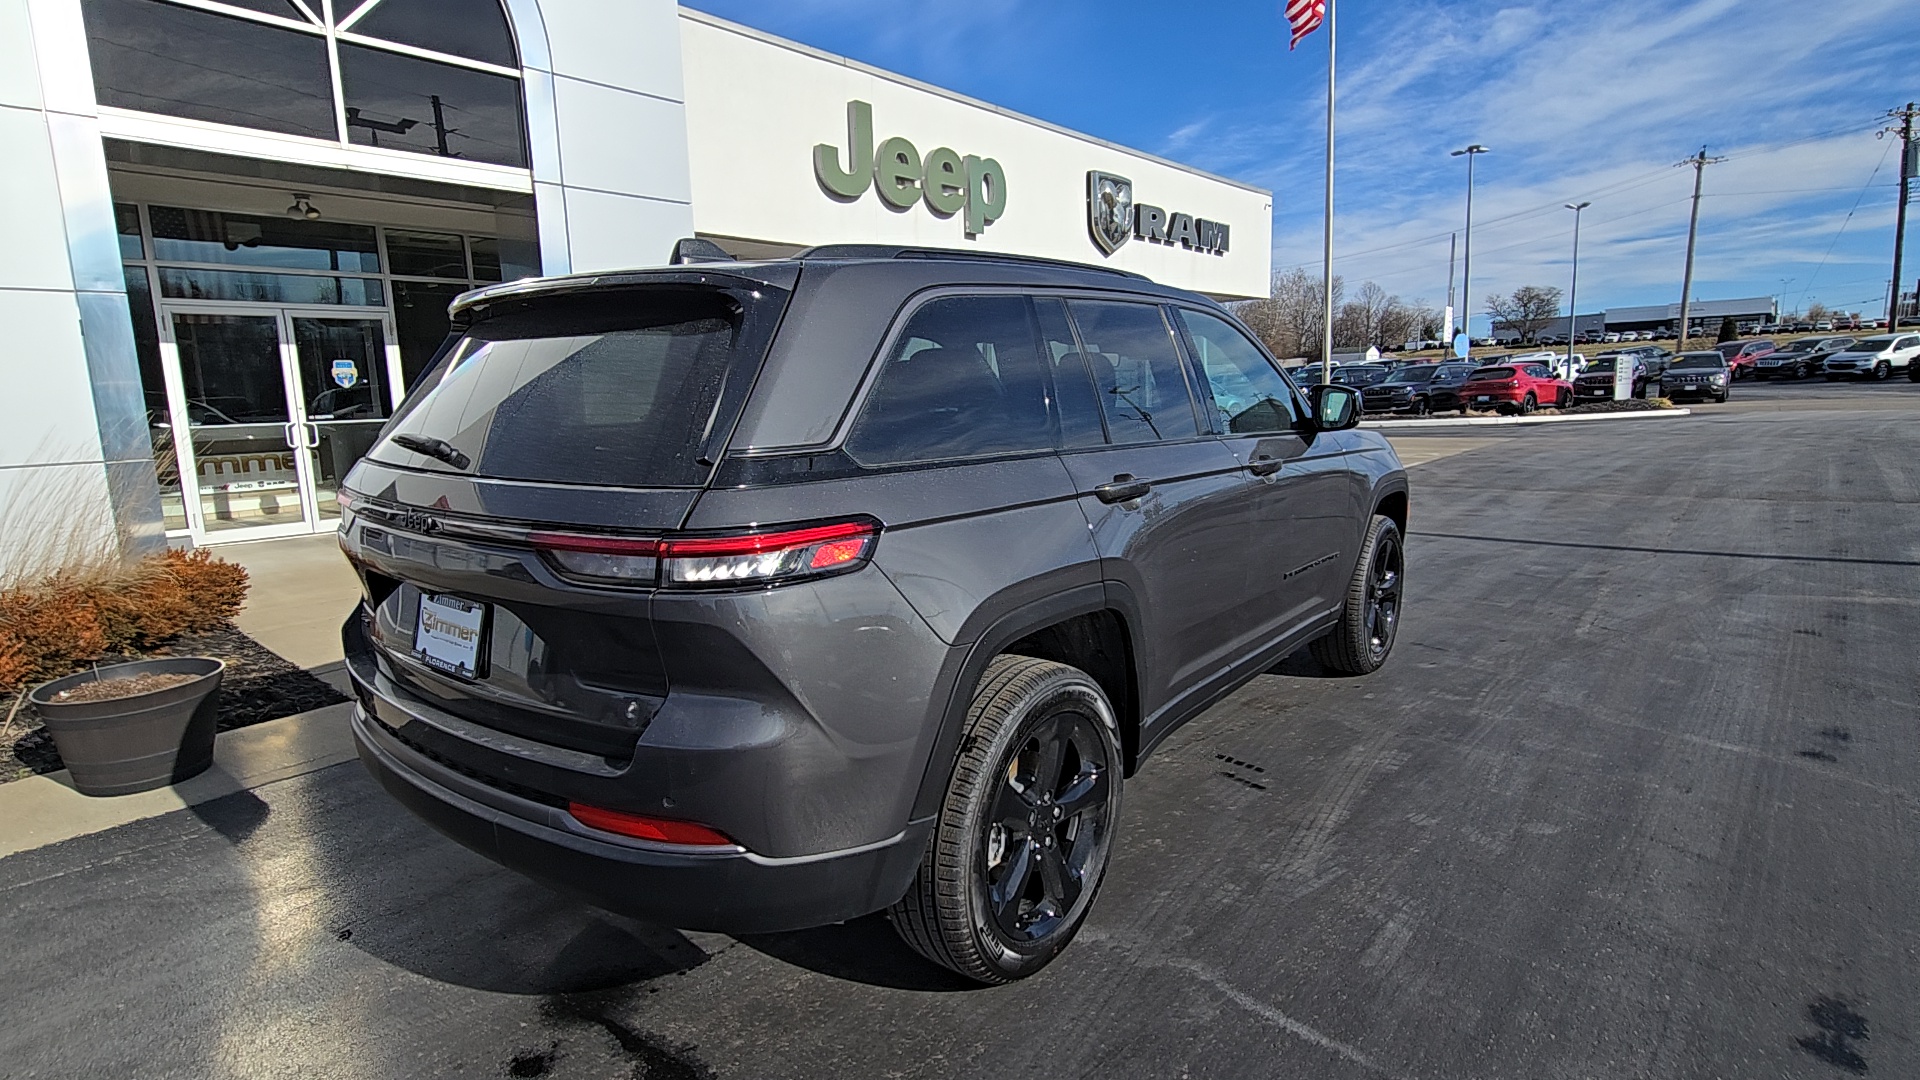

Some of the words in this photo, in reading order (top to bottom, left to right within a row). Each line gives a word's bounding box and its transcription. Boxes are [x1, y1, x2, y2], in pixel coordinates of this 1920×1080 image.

[814, 100, 1006, 238] Jeep
[1133, 203, 1230, 253] RAM
[423, 609, 478, 642] Zimmer
[425, 655, 456, 673] FLORENCE
